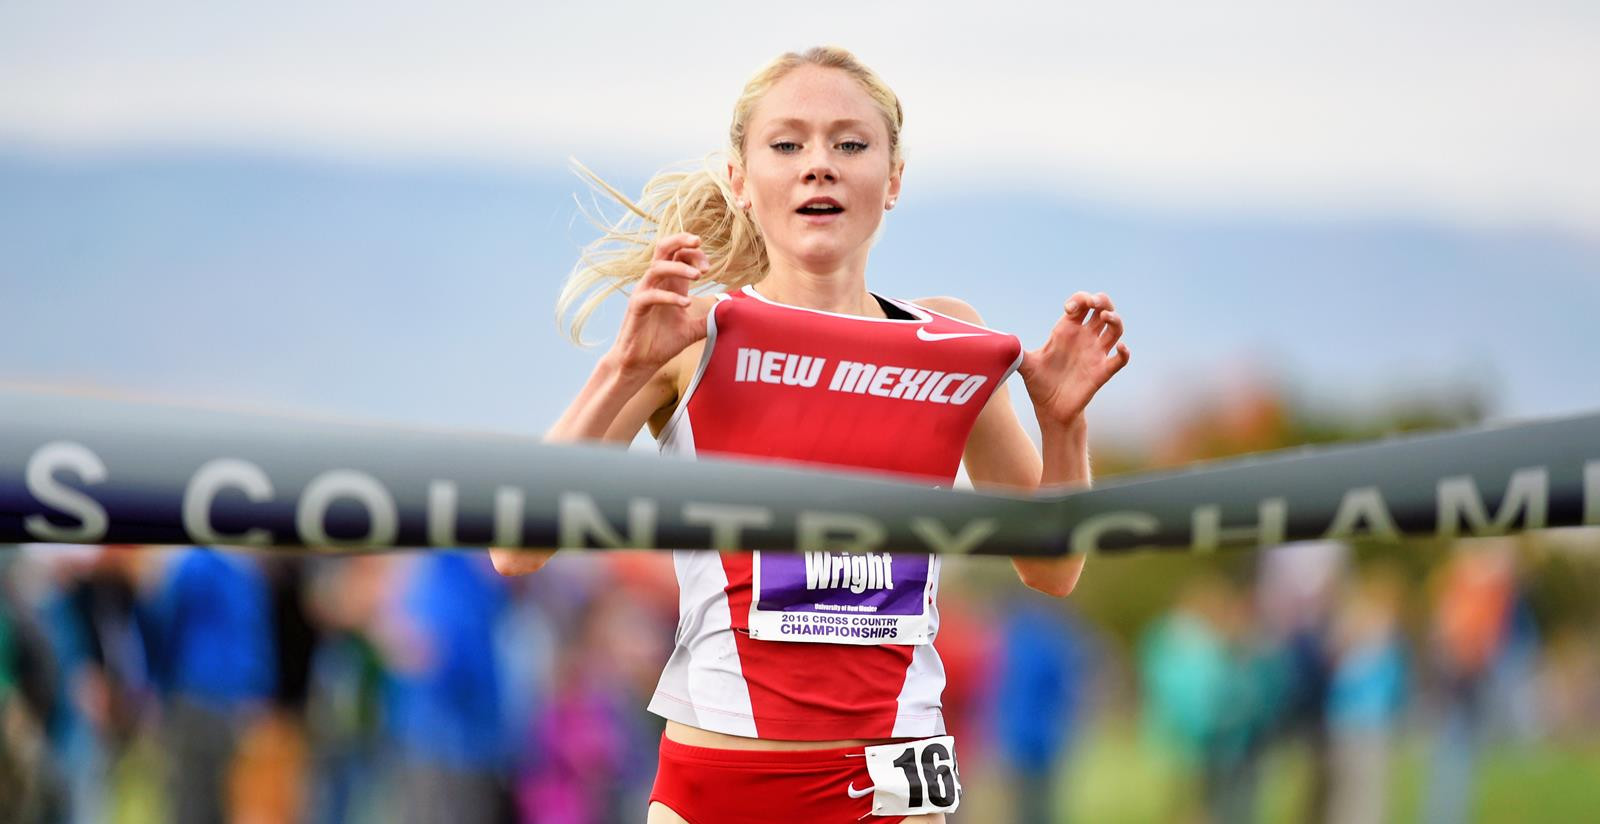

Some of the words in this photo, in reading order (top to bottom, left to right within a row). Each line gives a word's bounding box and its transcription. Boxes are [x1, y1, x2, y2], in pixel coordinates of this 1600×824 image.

[735, 347, 826, 387] NEW
[828, 360, 988, 405] MEXICO
[182, 457, 998, 555] COUNTRY
[804, 551, 893, 594] Wright
[781, 614, 809, 623] 2016
[812, 615, 848, 625] CROSS
[852, 617, 898, 626] COUNTRY
[814, 603, 841, 612] University
[841, 604, 847, 612] of
[847, 604, 859, 612] New
[780, 624, 898, 638] CHAMPIONSHIPS
[893, 743, 961, 807] 16
